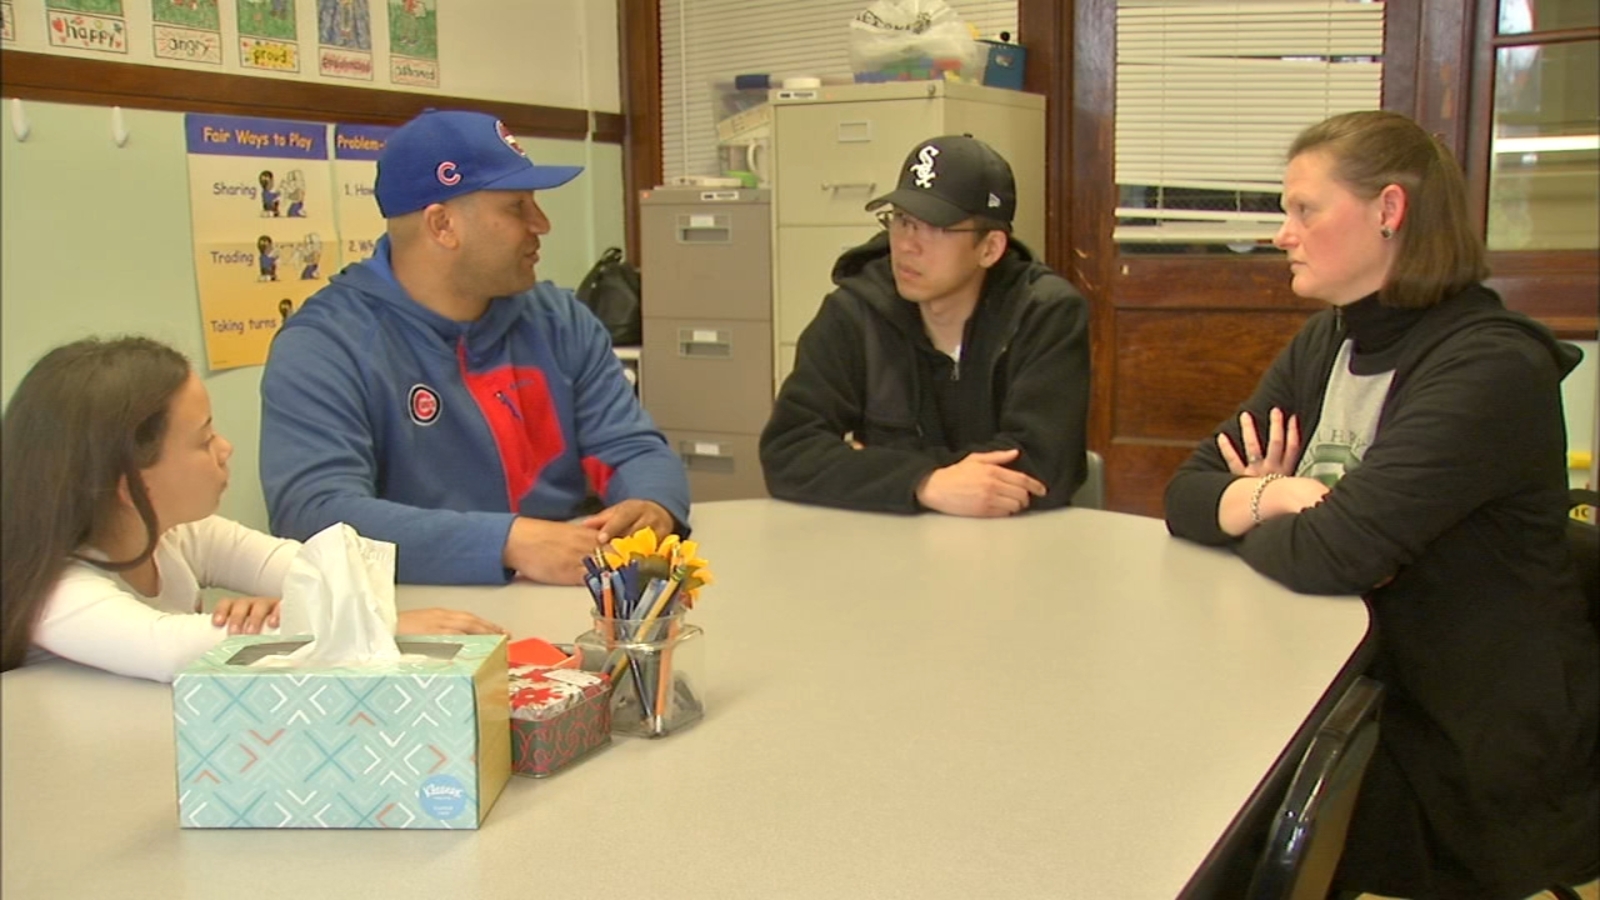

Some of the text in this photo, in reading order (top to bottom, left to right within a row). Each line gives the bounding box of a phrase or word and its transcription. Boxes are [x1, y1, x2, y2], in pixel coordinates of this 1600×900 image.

[65, 18, 116, 48] happy
[168, 37, 210, 57] angry
[253, 48, 288, 65] proud
[203, 127, 313, 149] Fair Ways to Play
[337, 134, 388, 151] Problem-
[437, 161, 462, 186] C
[213, 183, 257, 199] Sharing
[211, 251, 255, 266] Trading
[211, 319, 277, 335] Taking turns
